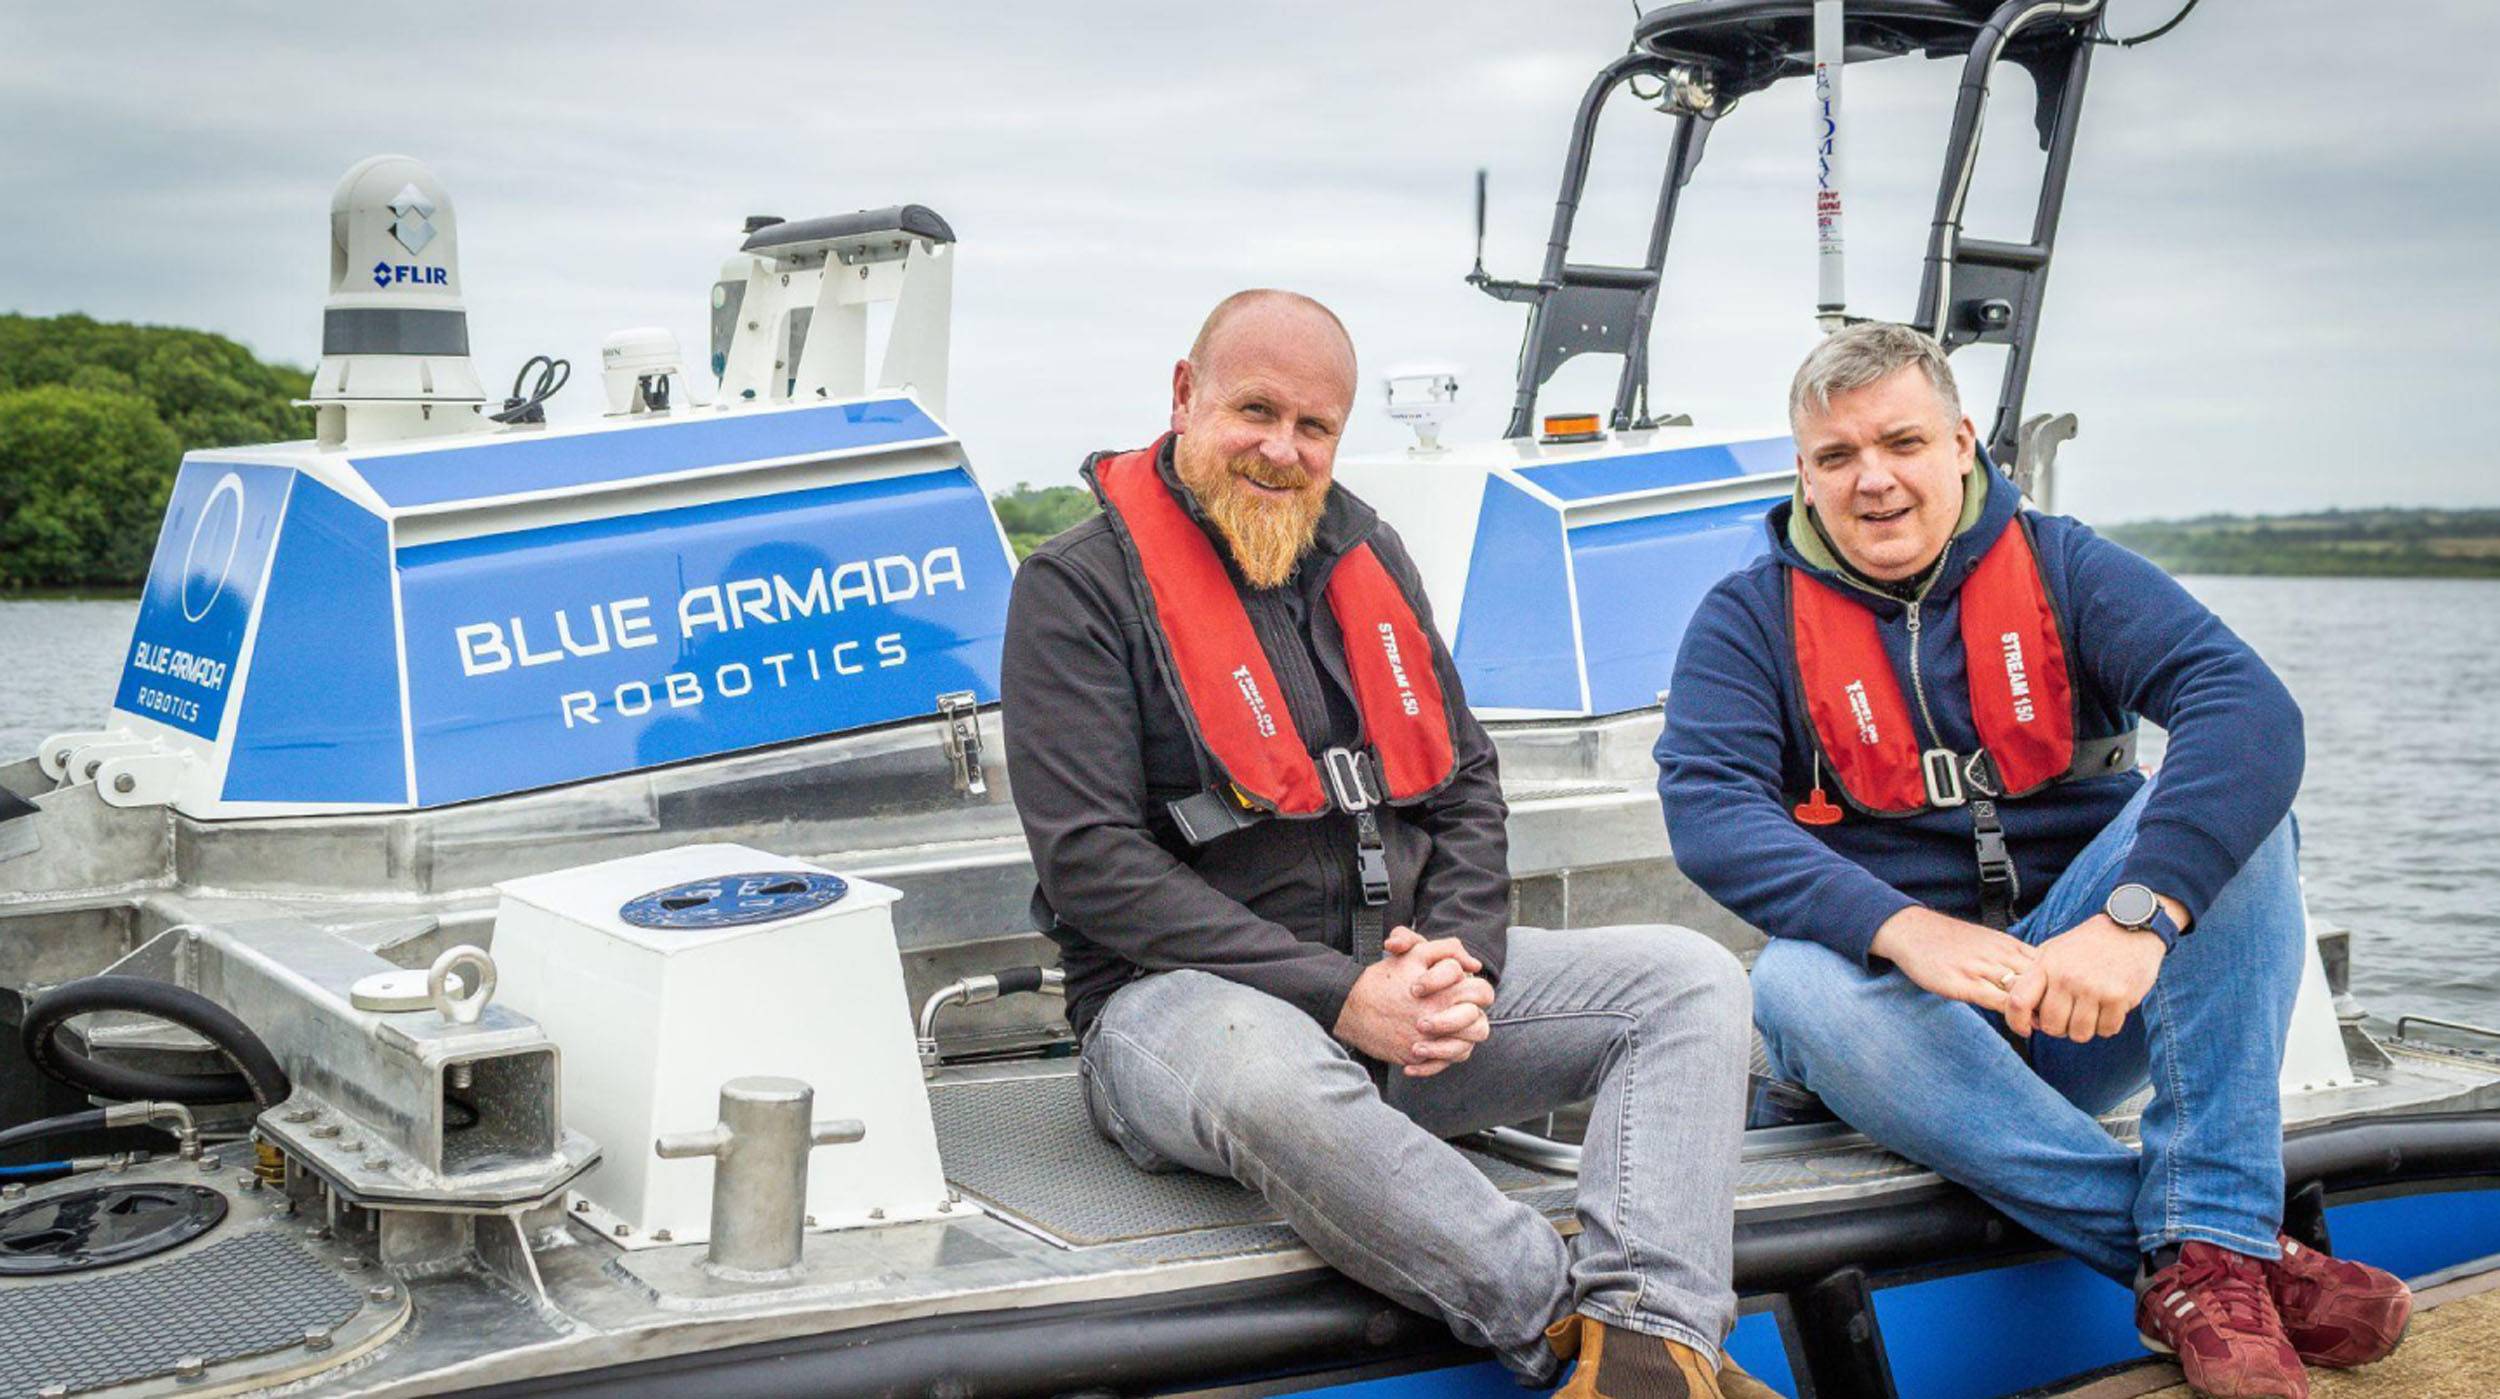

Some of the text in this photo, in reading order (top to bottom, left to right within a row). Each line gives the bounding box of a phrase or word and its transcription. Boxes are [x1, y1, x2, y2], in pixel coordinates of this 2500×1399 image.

[395, 265, 448, 285] FLIR
[454, 546, 966, 677] BLUE ARMADA
[134, 641, 226, 691] BLUE ARMADA
[137, 686, 200, 723] ROBOTICS
[560, 633, 908, 729] ROBOTICS
[1378, 622, 1420, 716] STREAM 150
[2001, 631, 2035, 722] STREAM 150
